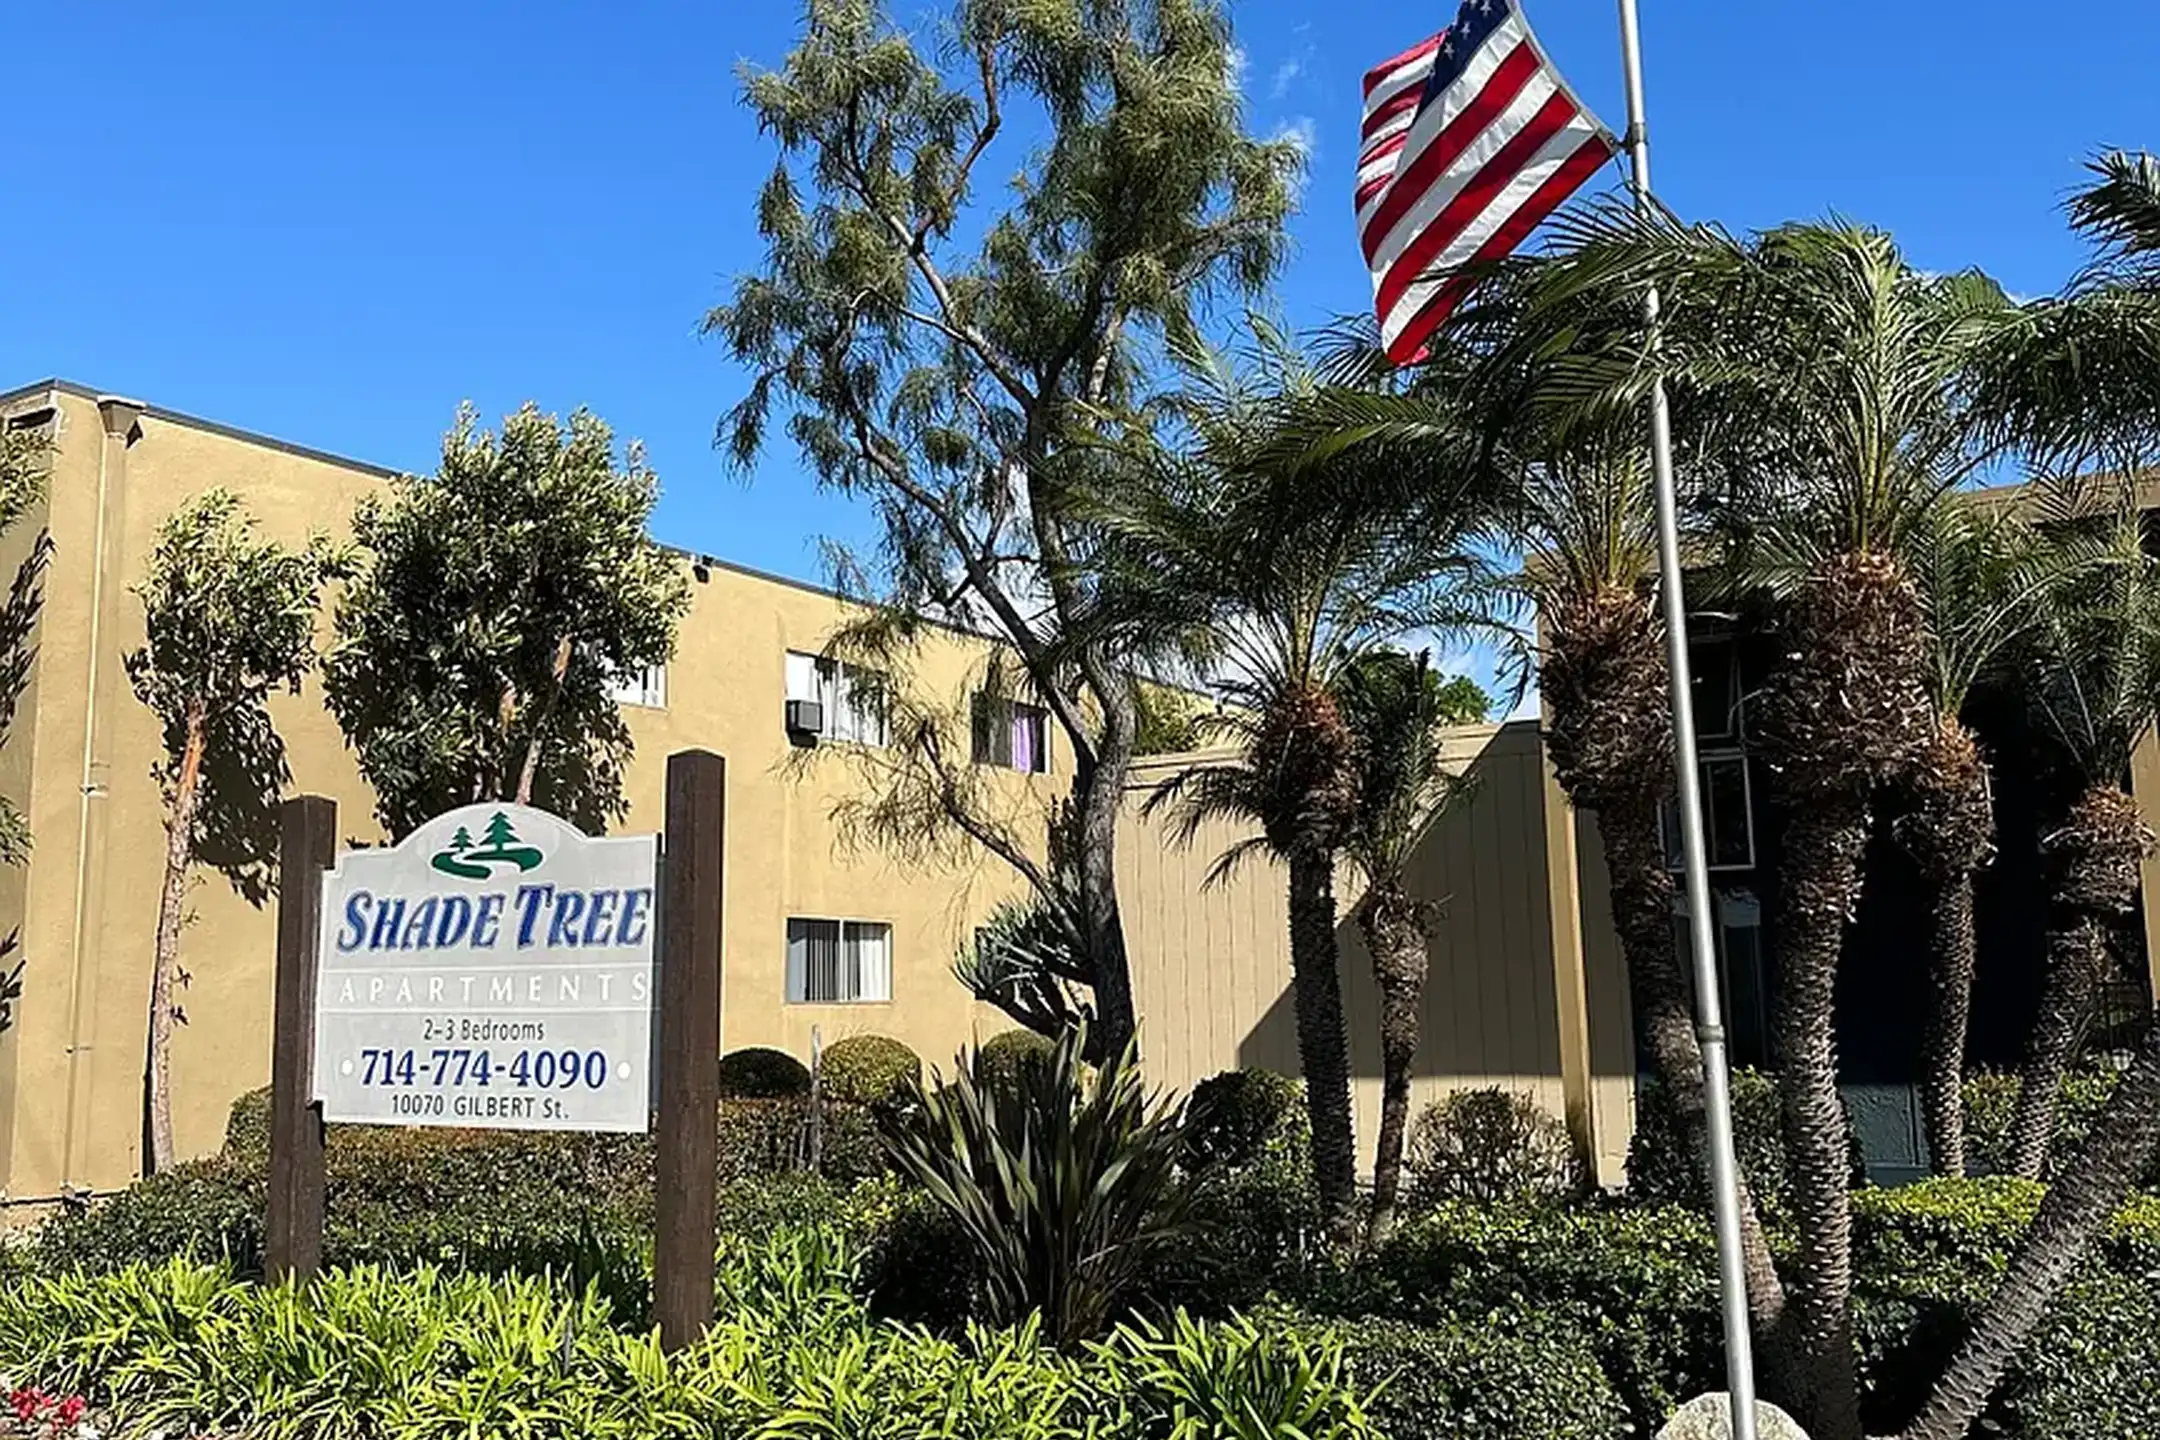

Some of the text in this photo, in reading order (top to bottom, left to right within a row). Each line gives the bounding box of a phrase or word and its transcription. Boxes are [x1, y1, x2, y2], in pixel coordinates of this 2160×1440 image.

[337, 883, 653, 953] SHADE TREE
[339, 971, 648, 1005] APARTMENTS
[423, 1018, 545, 1041] 2-3 Bedrooms
[361, 1048, 607, 1089] 714-774-4090
[392, 1094, 570, 1119] 10070 GILBERT St.
